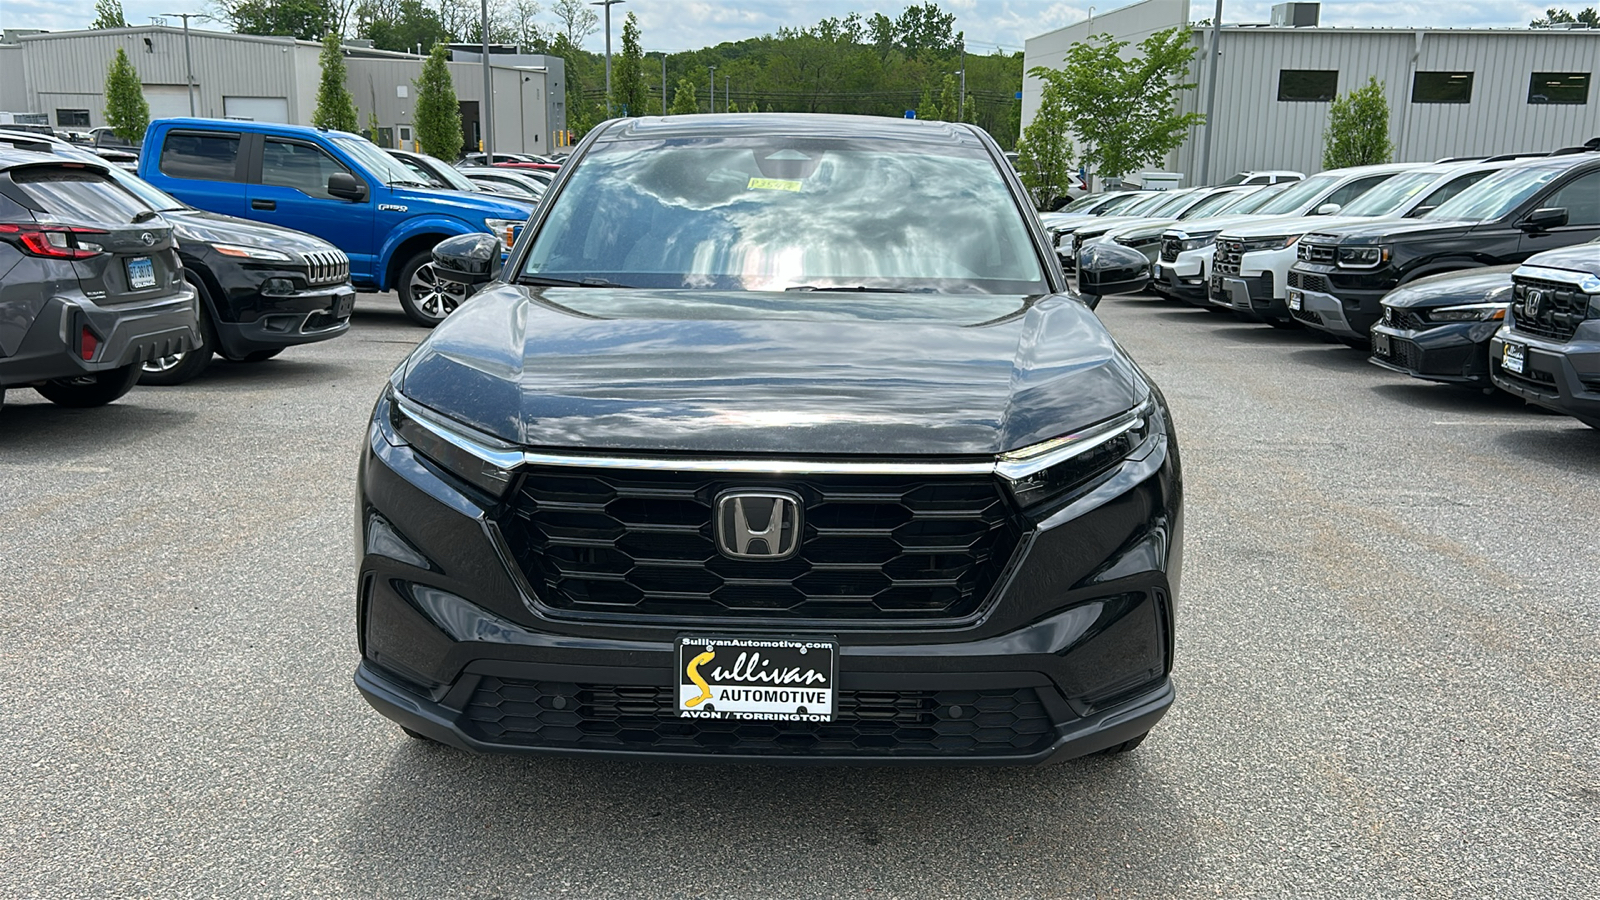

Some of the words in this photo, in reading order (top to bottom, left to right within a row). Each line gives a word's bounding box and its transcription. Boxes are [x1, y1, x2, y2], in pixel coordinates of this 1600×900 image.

[682, 638, 833, 649] SullivanAutomotive.com
[685, 651, 826, 708] Sullivan
[719, 689, 826, 704] AUTOMOTIVE
[680, 711, 722, 719] AVON
[733, 712, 831, 722] TORRINGTON
